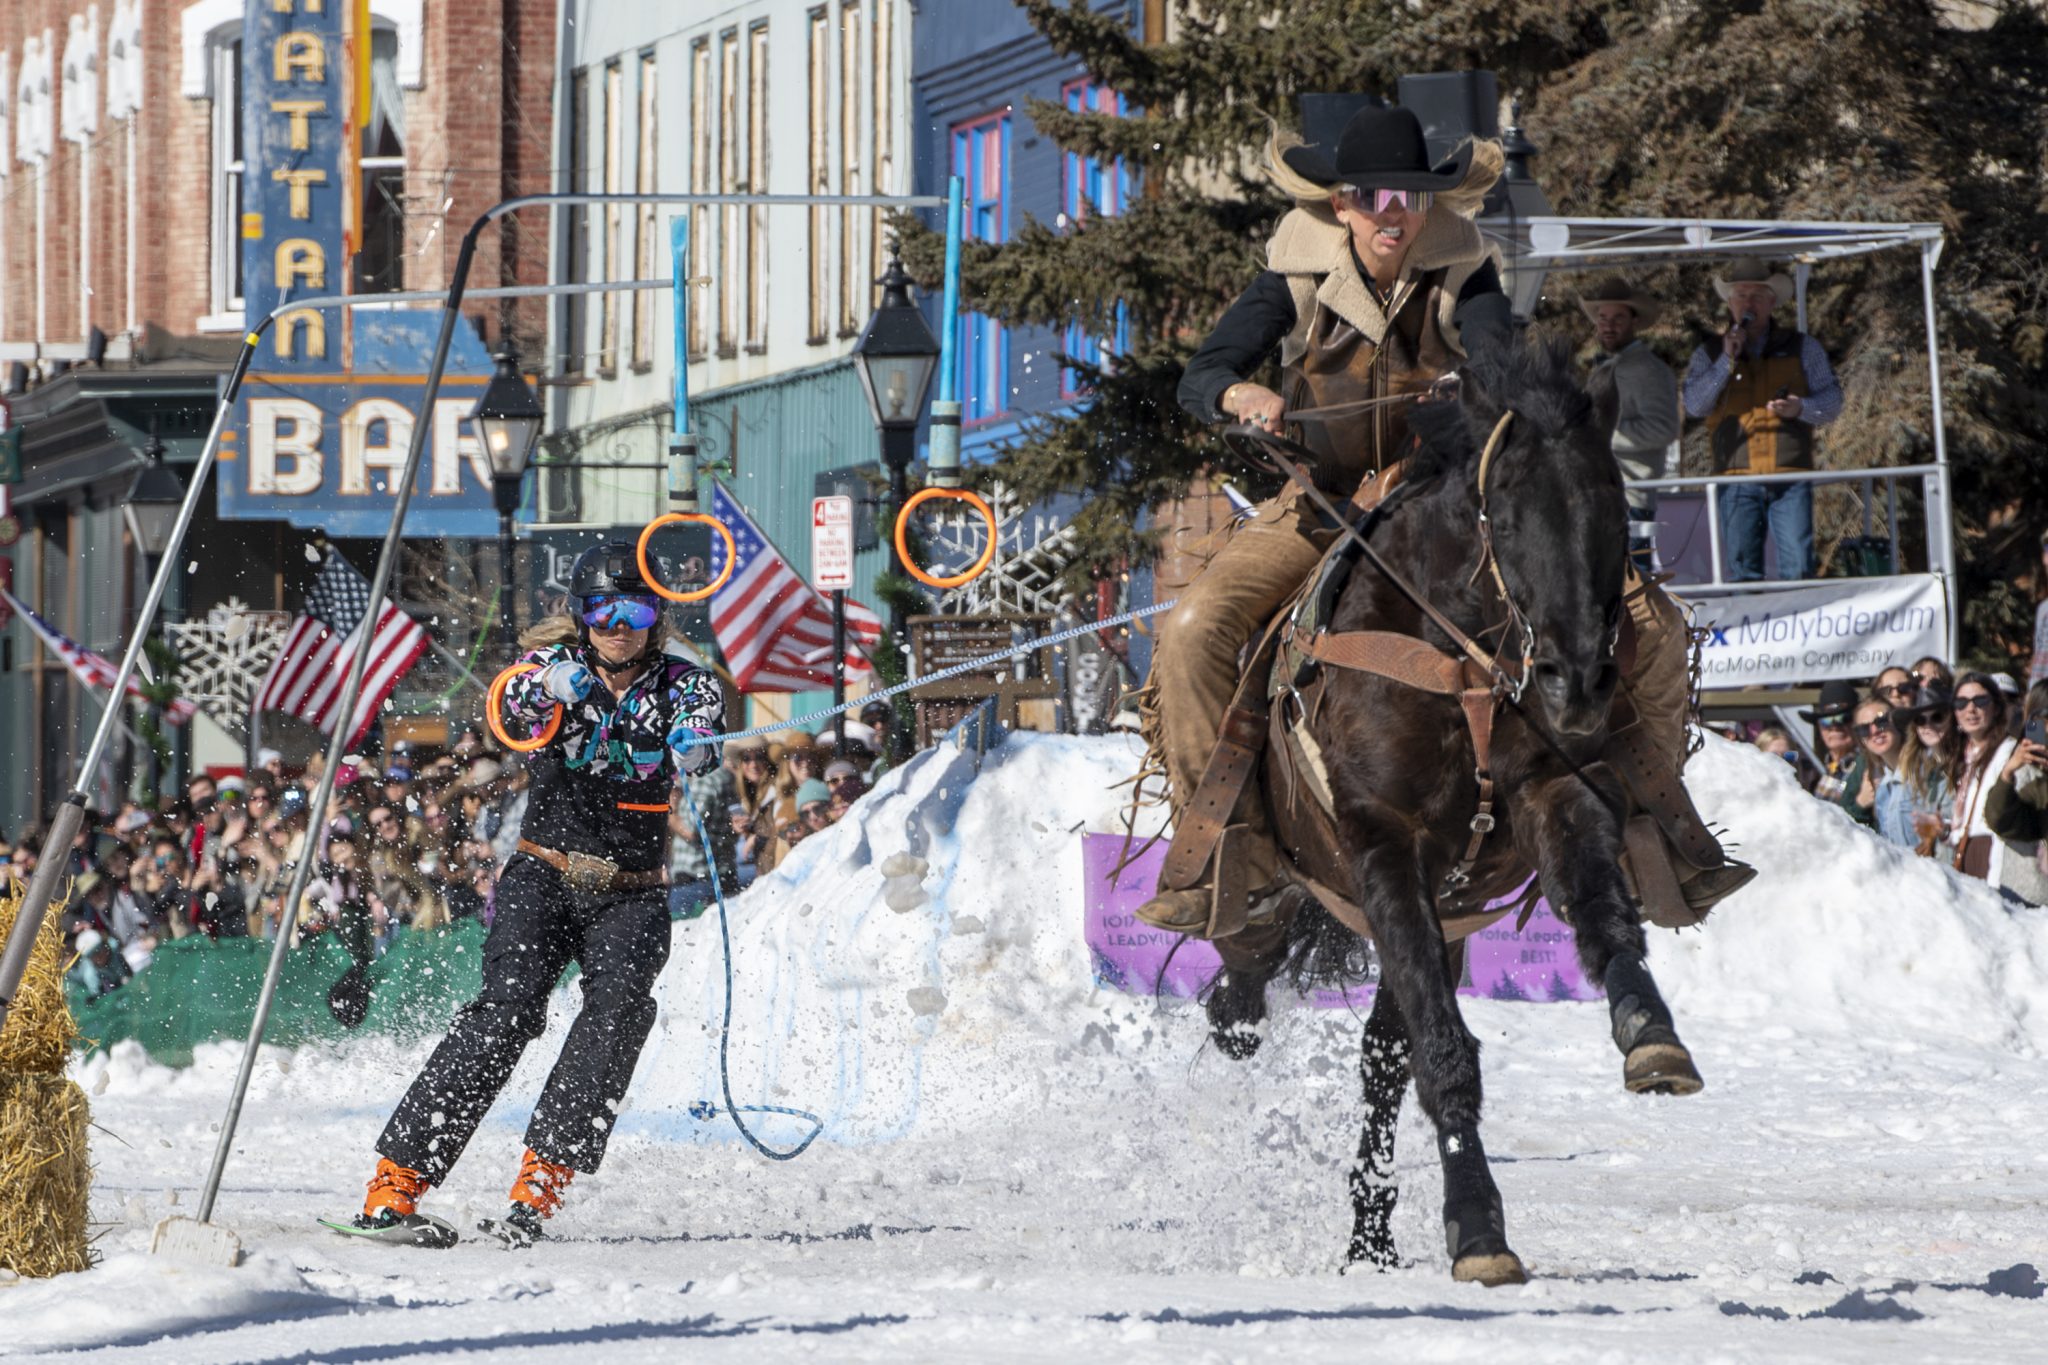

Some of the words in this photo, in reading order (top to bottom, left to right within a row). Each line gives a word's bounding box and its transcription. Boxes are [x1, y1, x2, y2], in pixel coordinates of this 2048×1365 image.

[248, 397, 494, 495] BAR
[816, 502, 825, 525] 4
[1739, 606, 1936, 648] Molybdenum
[1804, 648, 1895, 670] Company
